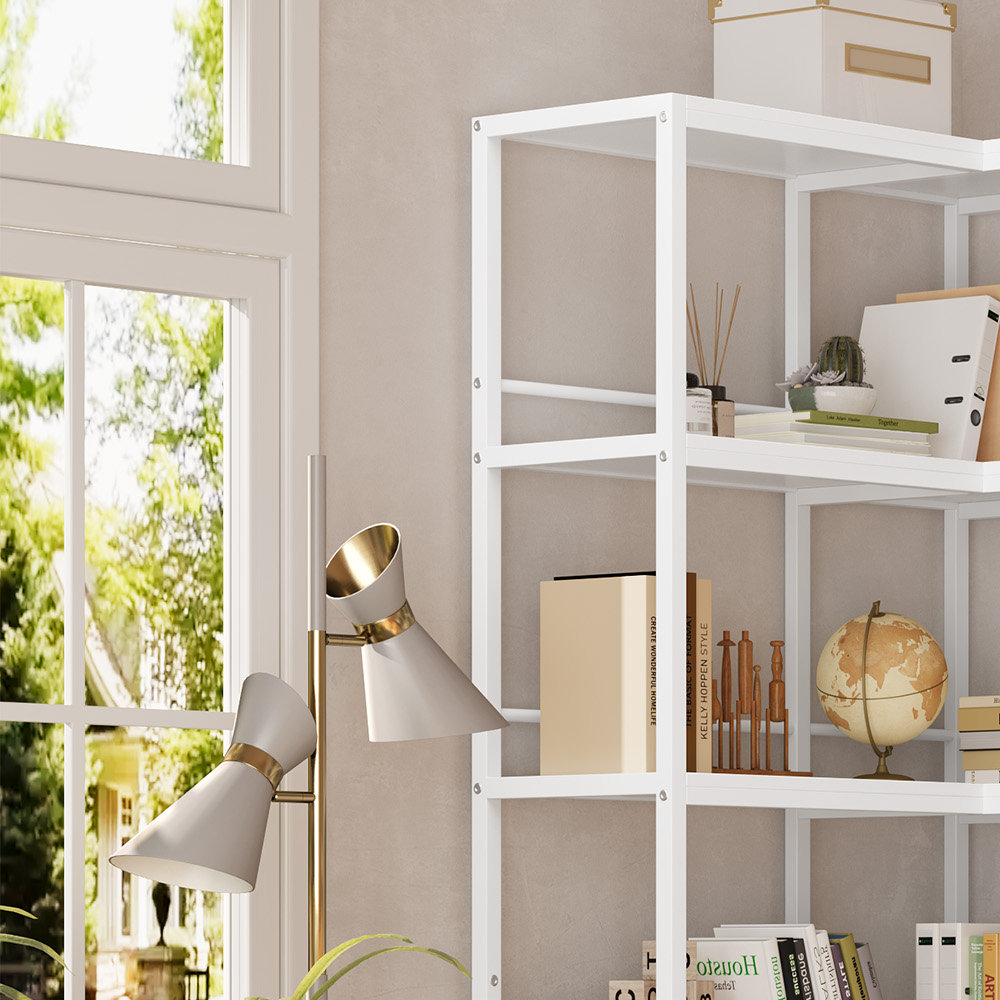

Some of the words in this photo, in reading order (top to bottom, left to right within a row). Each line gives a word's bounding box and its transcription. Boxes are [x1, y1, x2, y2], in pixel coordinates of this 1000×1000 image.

[878, 418, 899, 427] Together
[700, 623, 708, 655] STYLE
[700, 659, 708, 703] HOPPEN
[700, 706, 708, 740] KELLY
[985, 974, 995, 1000] ART
